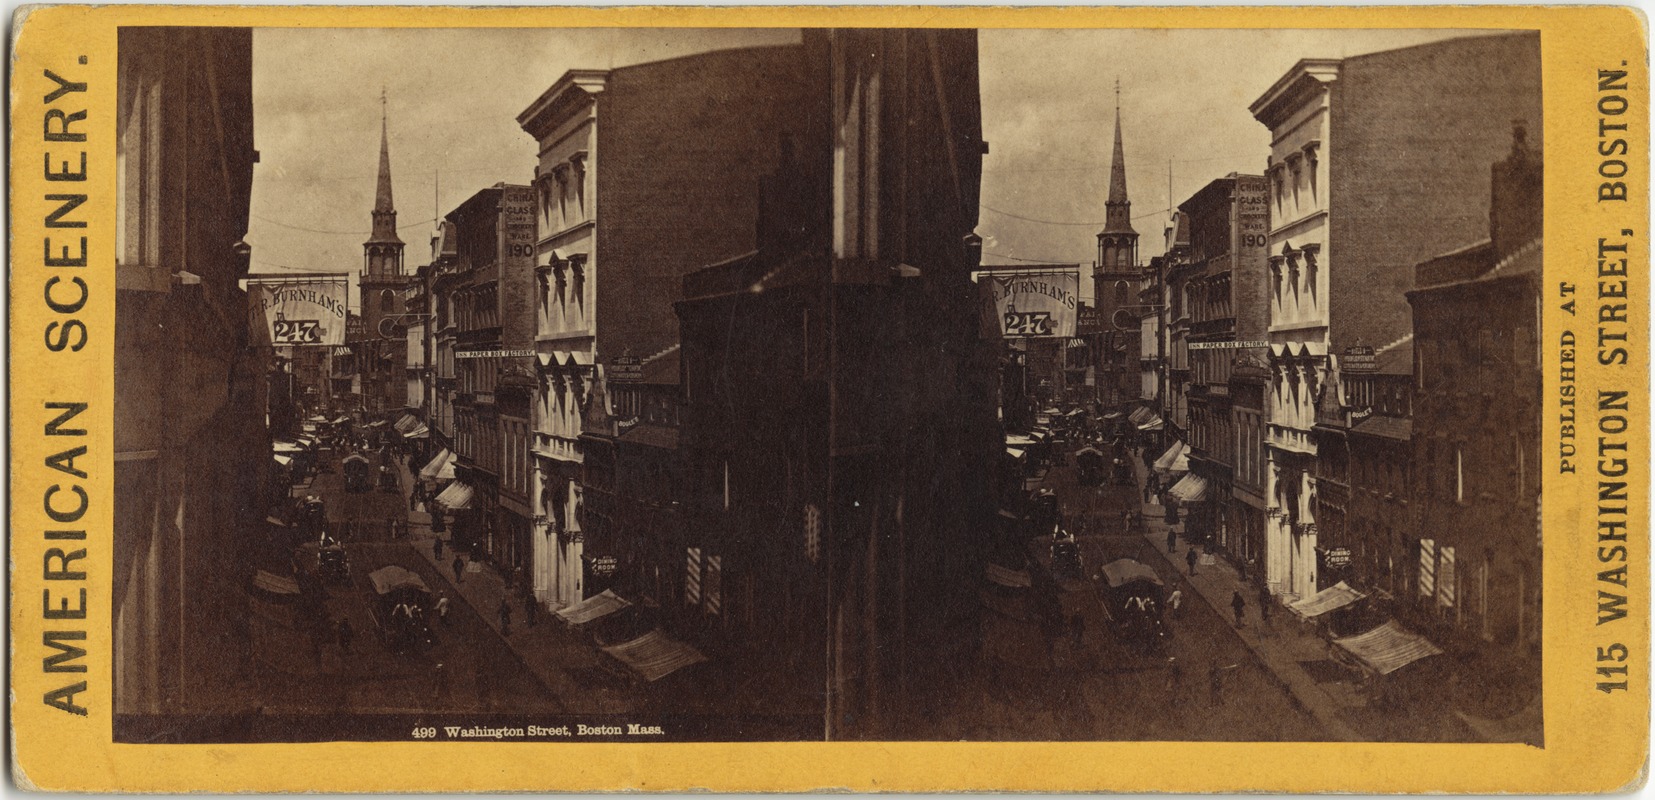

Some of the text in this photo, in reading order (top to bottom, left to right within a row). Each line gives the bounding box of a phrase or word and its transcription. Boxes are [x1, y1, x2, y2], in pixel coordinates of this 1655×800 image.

[506, 206, 536, 215] GLASS
[1239, 196, 1268, 205] GLASS
[508, 243, 534, 258] 190
[1241, 233, 1267, 248] 190
[274, 321, 318, 343] 247
[1005, 313, 1049, 335] 247
[42, 54, 91, 718] AMERICAN SCENERY.
[1559, 280, 1576, 475] PUBLISHED AT
[1595, 59, 1635, 694] 115 WASHINGTON STREET, BOSTON.
